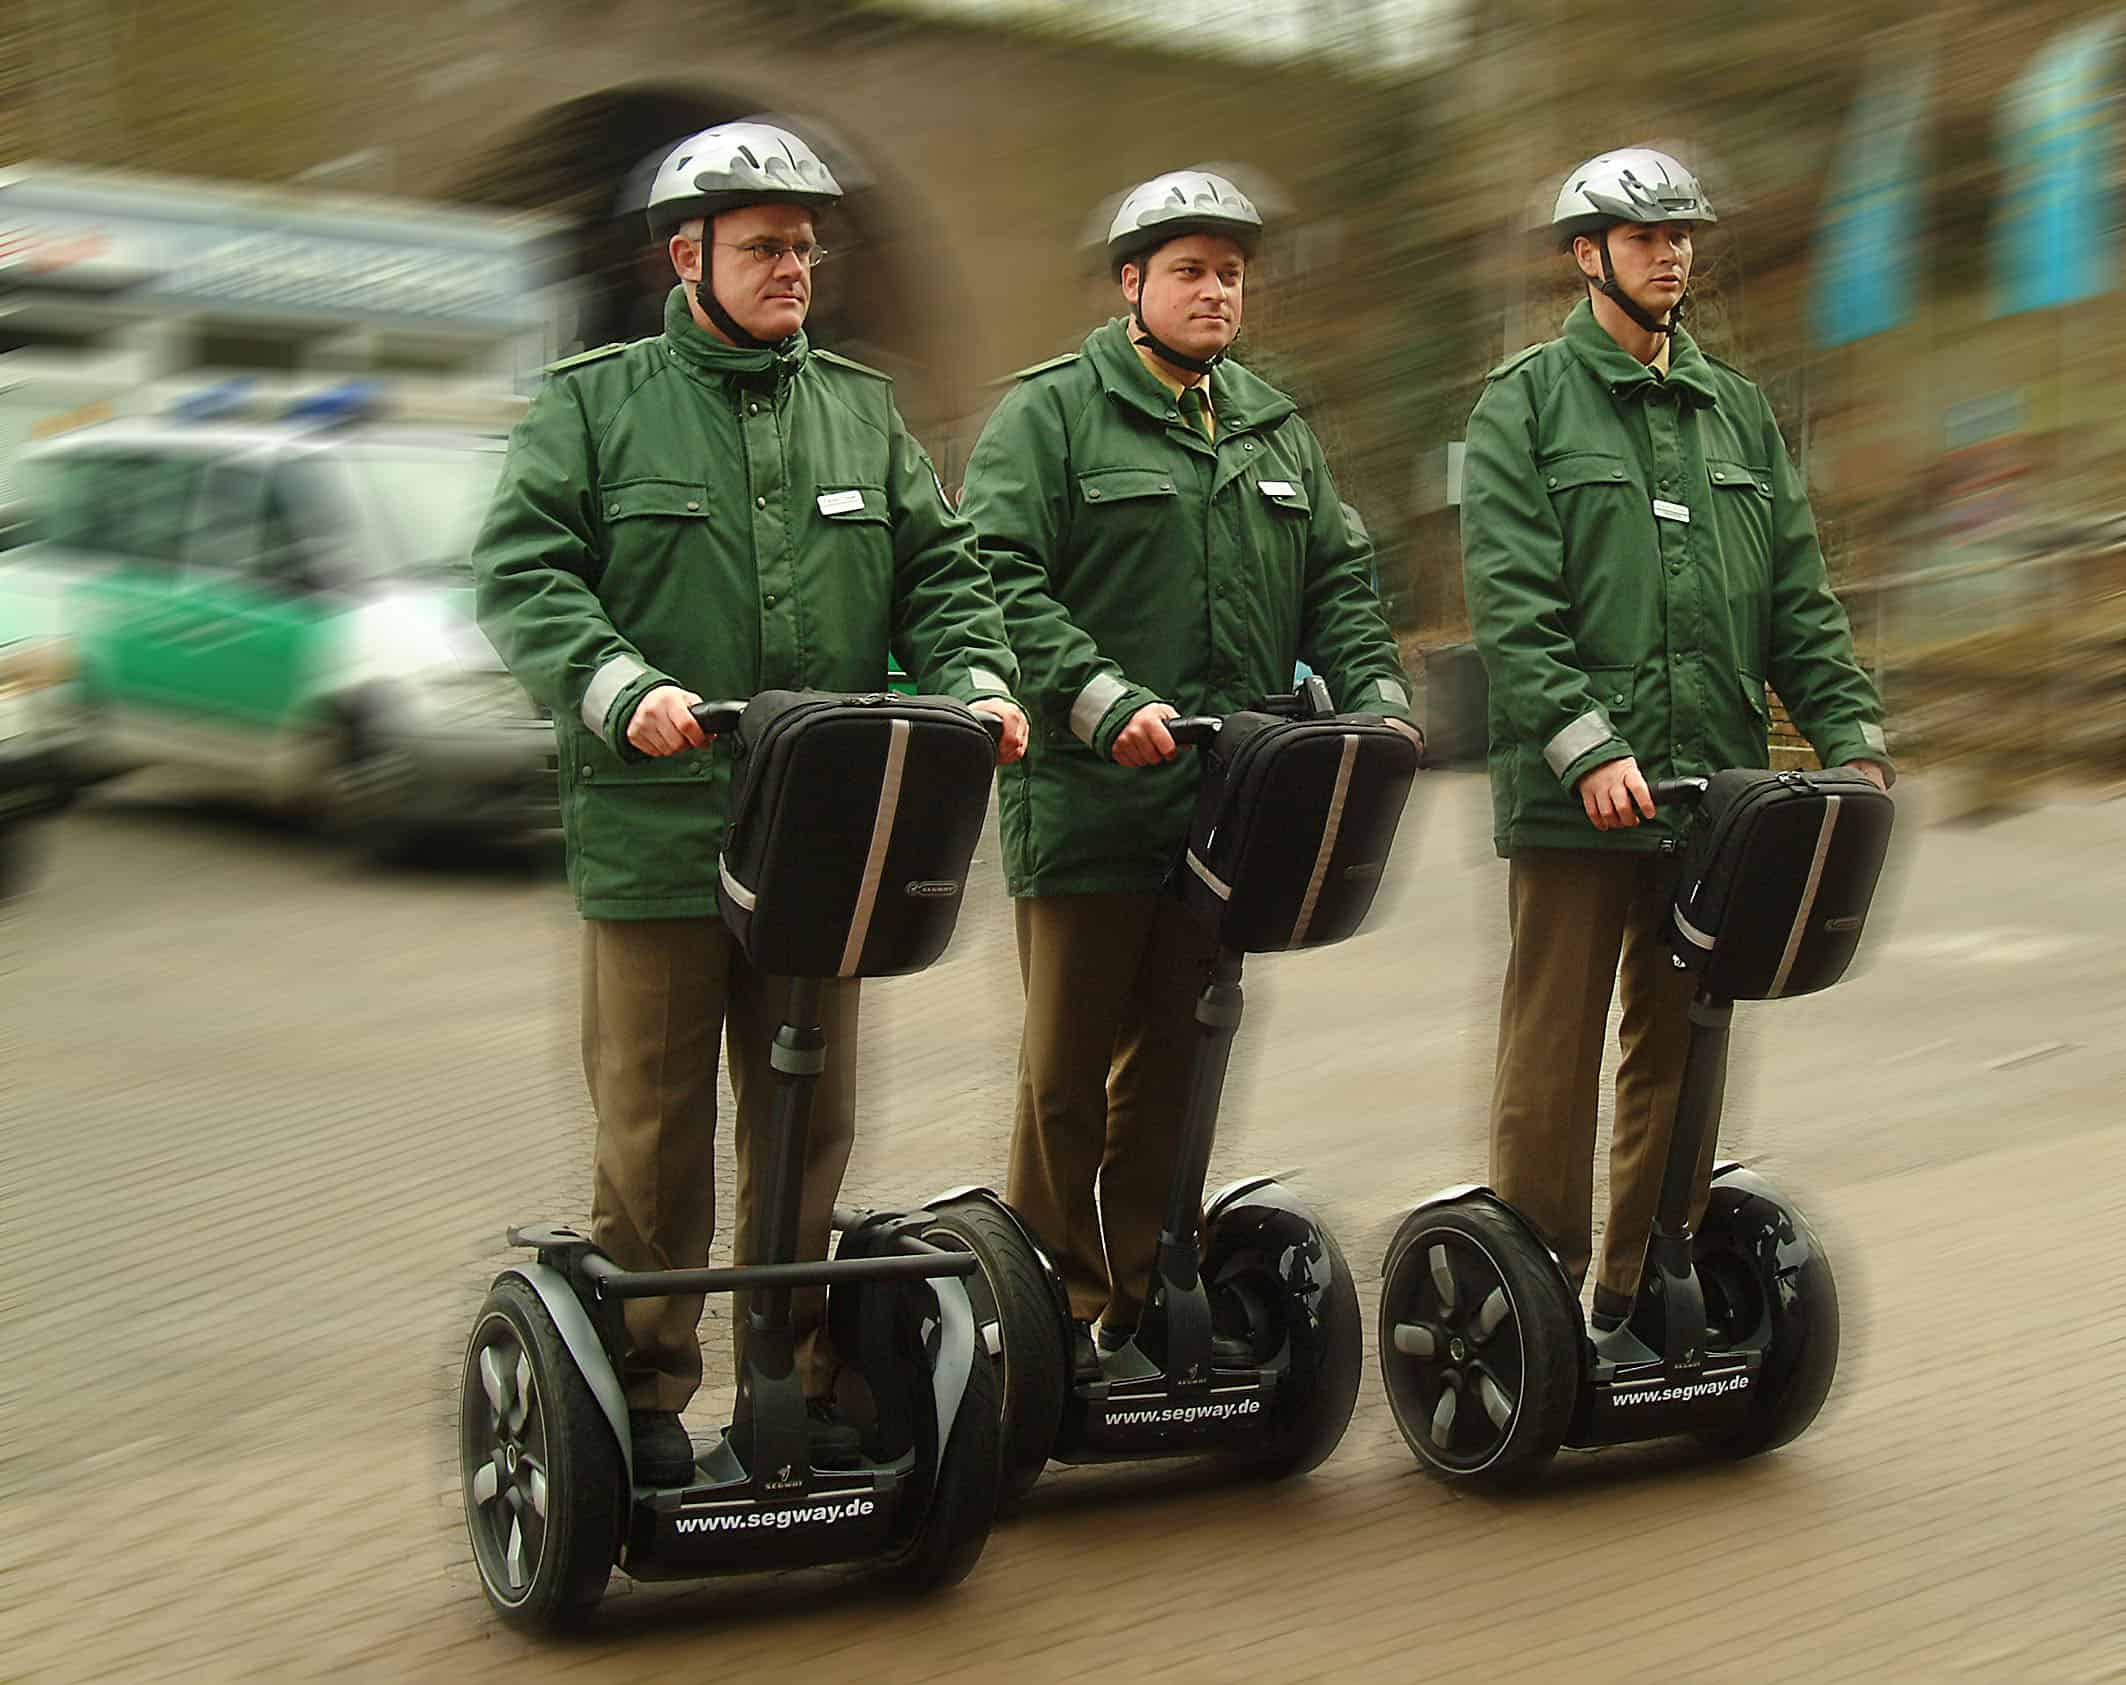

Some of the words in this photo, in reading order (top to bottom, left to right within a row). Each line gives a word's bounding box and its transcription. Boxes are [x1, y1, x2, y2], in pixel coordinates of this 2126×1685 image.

[1612, 1374, 1749, 1407] www.segway.de
[1105, 1398, 1260, 1425] www.segway.de
[675, 1498, 874, 1533] www.segway.de
